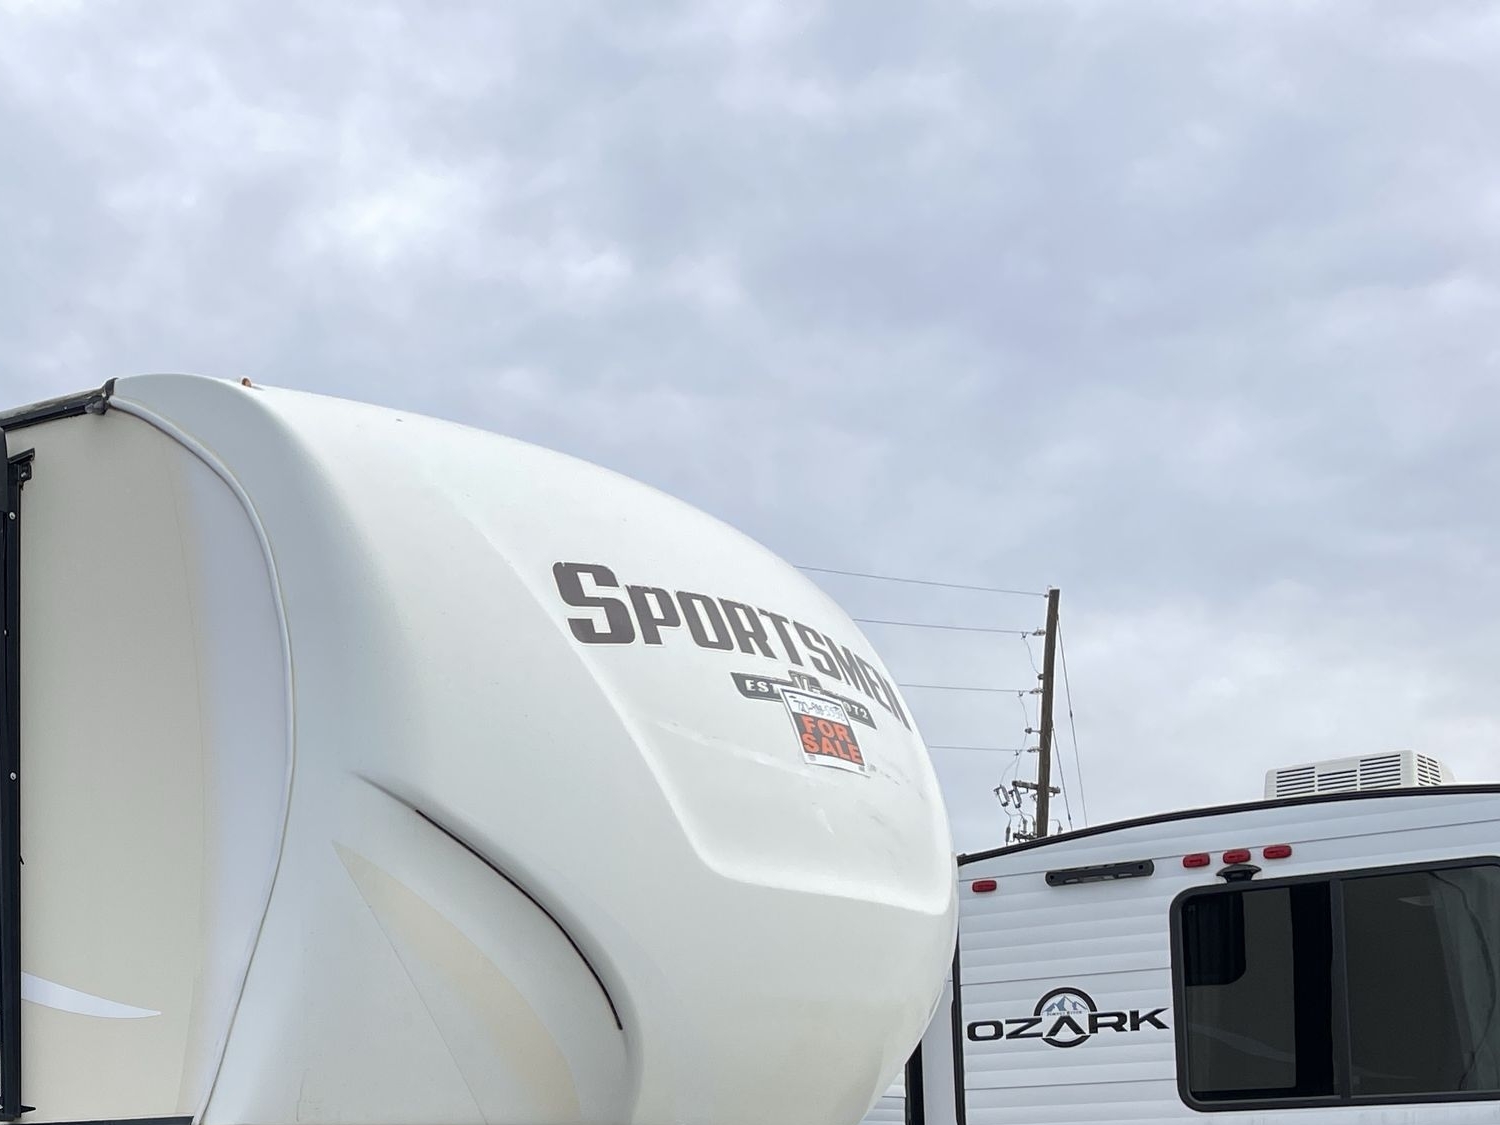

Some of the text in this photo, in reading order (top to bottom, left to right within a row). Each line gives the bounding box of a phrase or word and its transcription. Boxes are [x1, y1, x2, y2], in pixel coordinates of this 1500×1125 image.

[552, 561, 913, 733] SPORTSMEN
[801, 714, 854, 743] FOR
[802, 733, 864, 765] SALE
[966, 1007, 1171, 1042] OZARK
